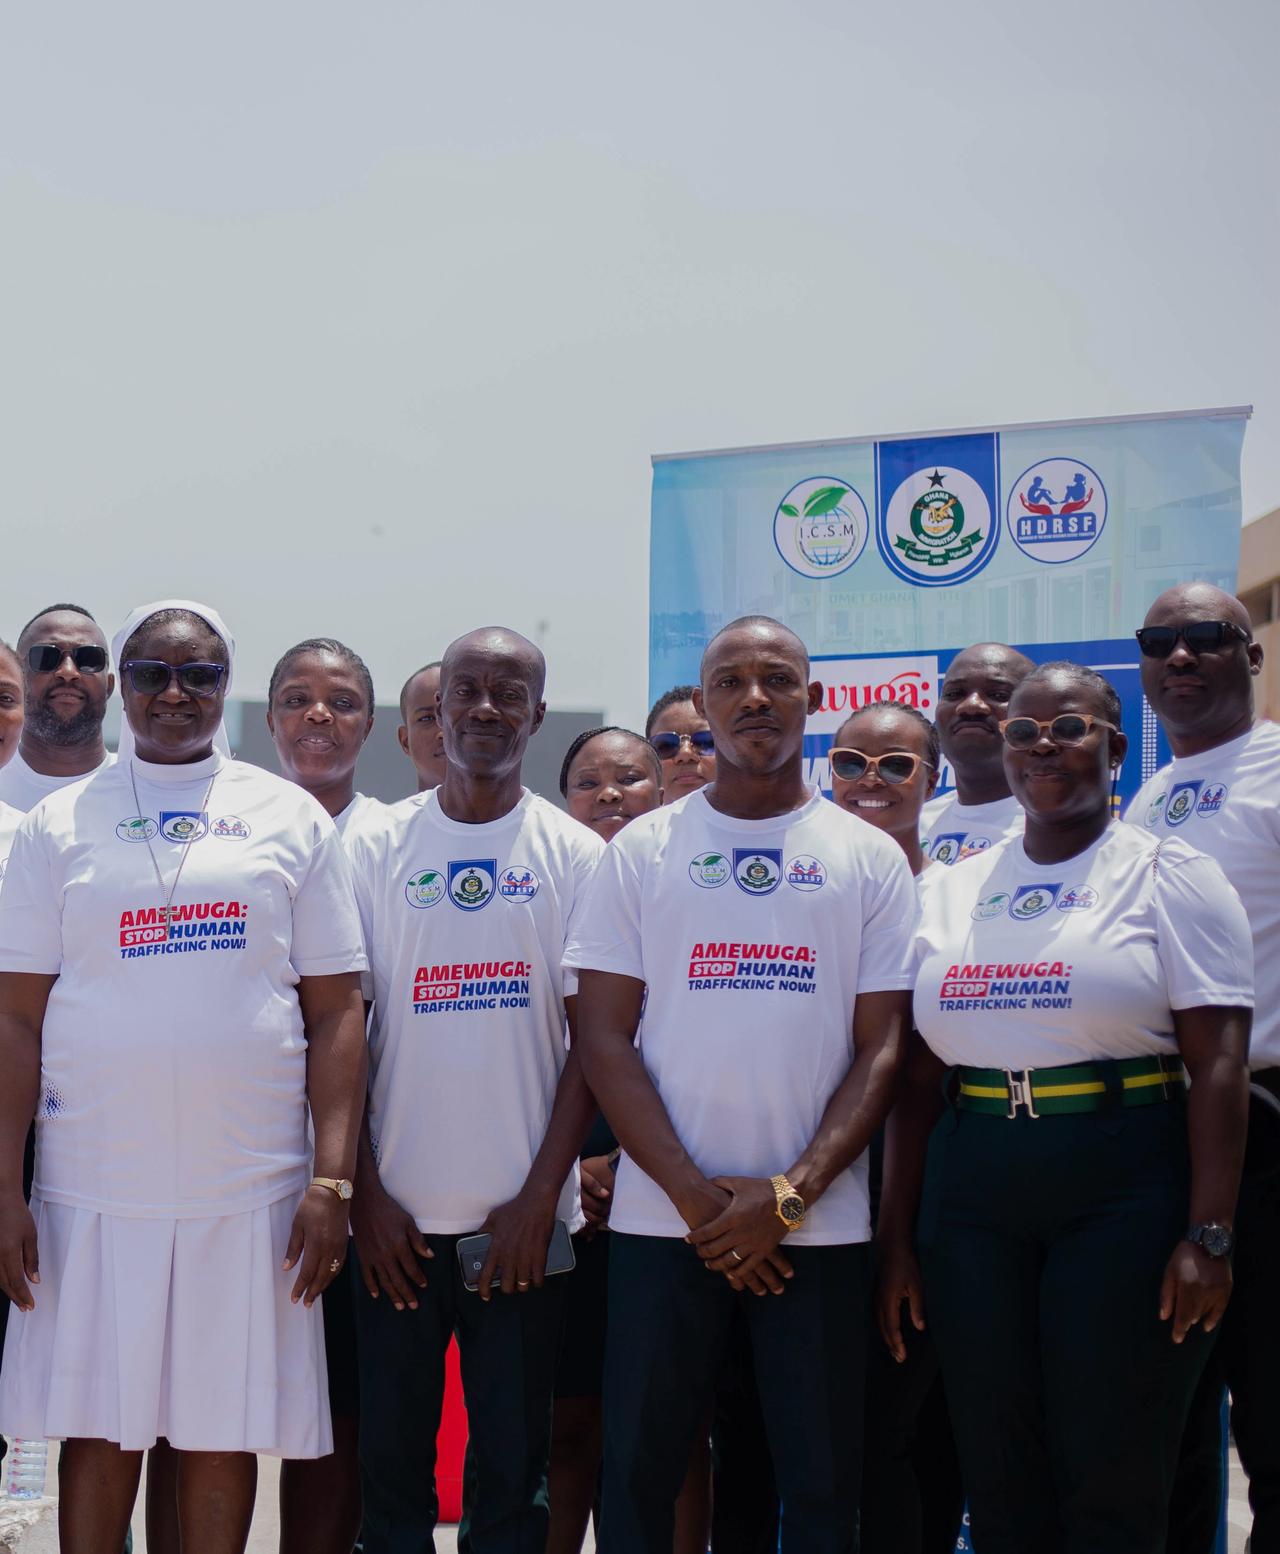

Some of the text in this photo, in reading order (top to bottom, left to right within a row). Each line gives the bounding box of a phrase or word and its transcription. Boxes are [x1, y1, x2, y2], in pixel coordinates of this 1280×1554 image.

[125, 921, 246, 944] STOP HUMAN
[121, 939, 247, 959] TRAFFICKING NOW!
[690, 943, 816, 963] AMEWUGA:
[414, 961, 531, 983] AMEWUGA:
[693, 962, 816, 979] STOP HUMAN
[944, 961, 1073, 980] AMEWUGA:
[418, 980, 529, 999] STOP HUMAN
[688, 979, 817, 994] TRAFFICKING NOW!
[944, 980, 1070, 996] STOP HUMAN
[413, 998, 497, 1014] TRAFFICKING
[940, 998, 1073, 1011] TRAFFICKING NOW!
